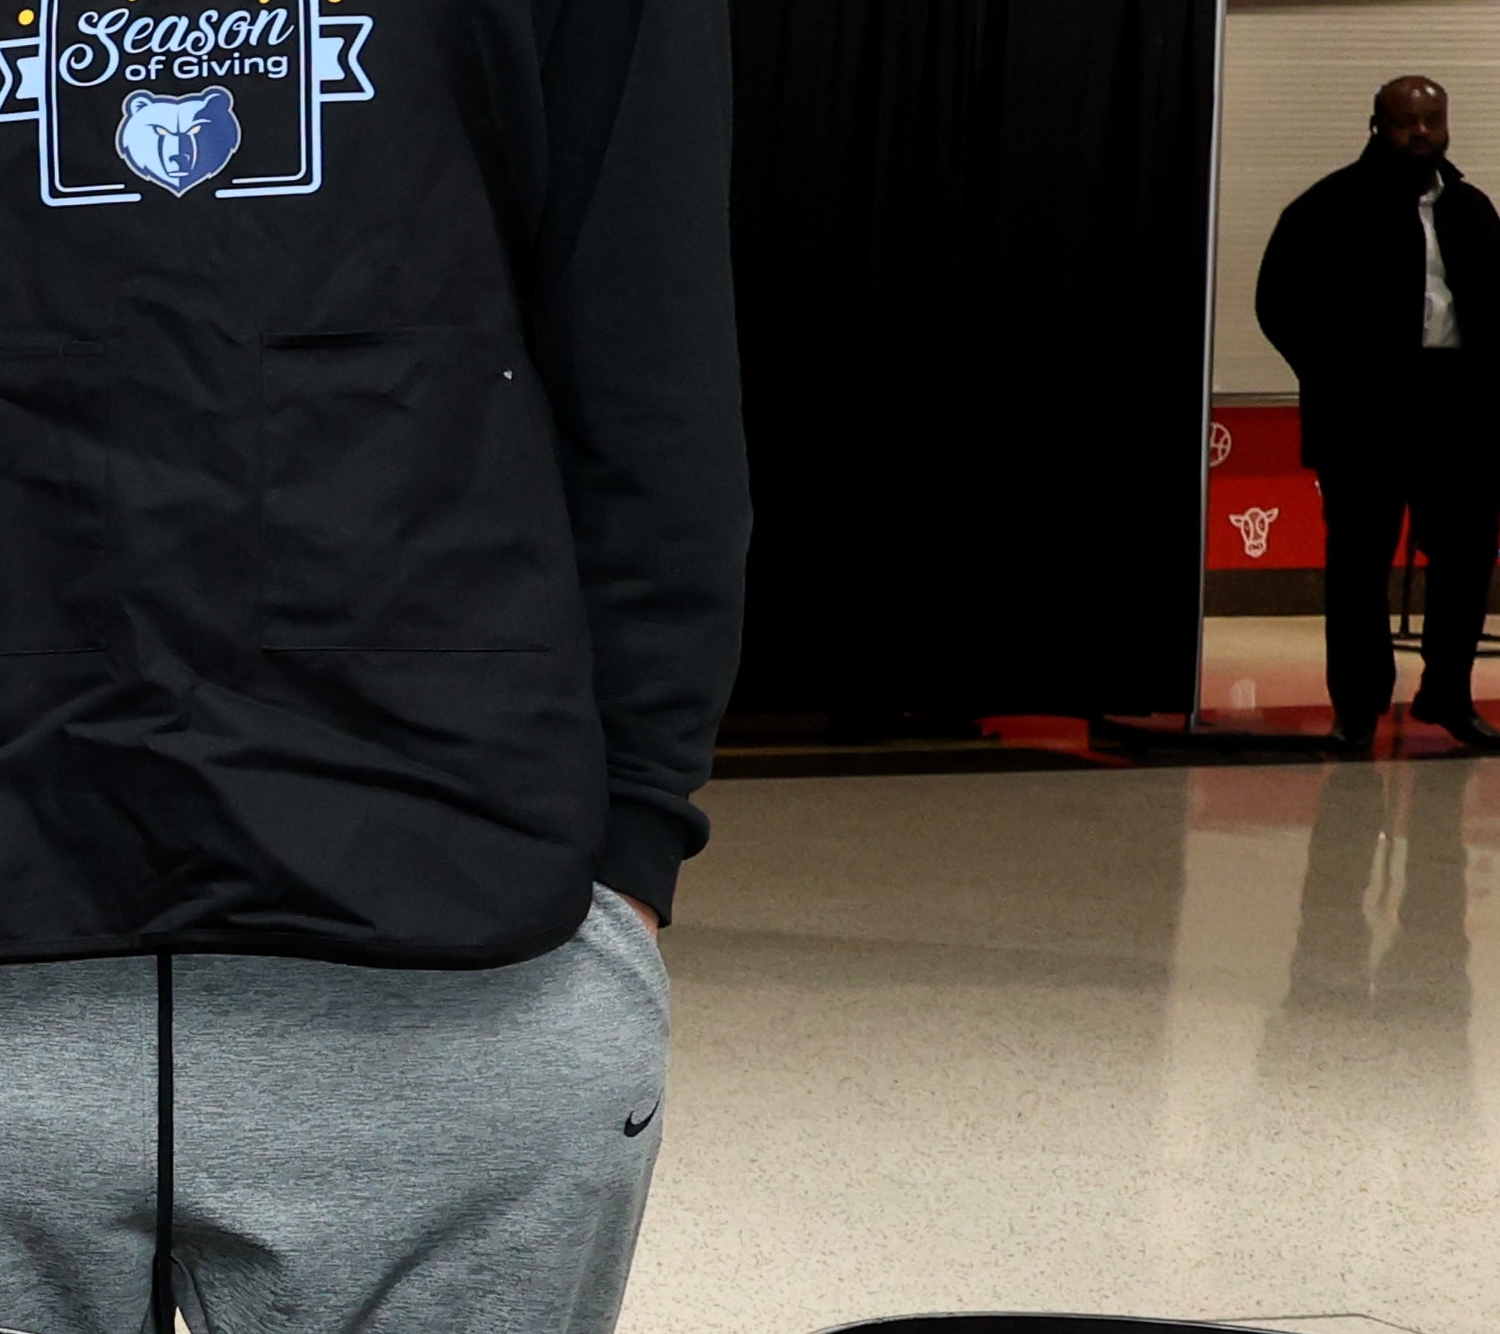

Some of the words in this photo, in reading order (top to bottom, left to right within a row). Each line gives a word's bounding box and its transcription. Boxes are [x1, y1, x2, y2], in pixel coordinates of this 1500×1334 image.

[58, 9, 295, 87] Season
[125, 56, 166, 81] of
[173, 55, 288, 79] Giving
